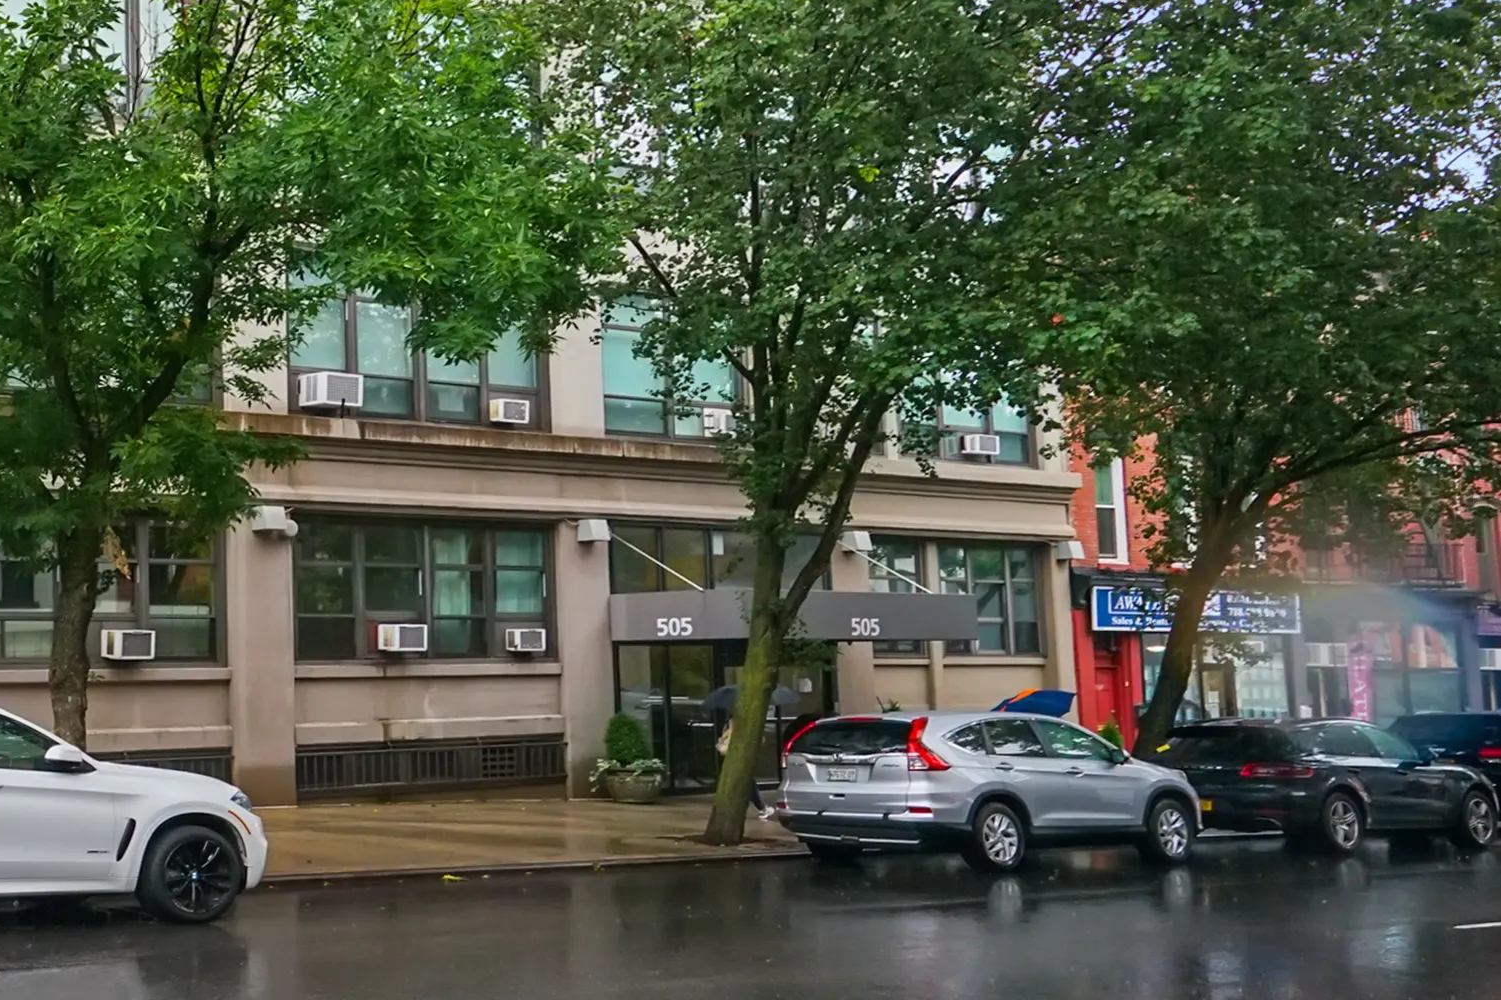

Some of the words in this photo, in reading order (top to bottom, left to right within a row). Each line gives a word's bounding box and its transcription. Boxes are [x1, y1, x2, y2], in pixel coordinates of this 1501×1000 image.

[656, 617, 693, 637] 505
[851, 617, 880, 636] 505
[1111, 616, 1134, 625] Sales
